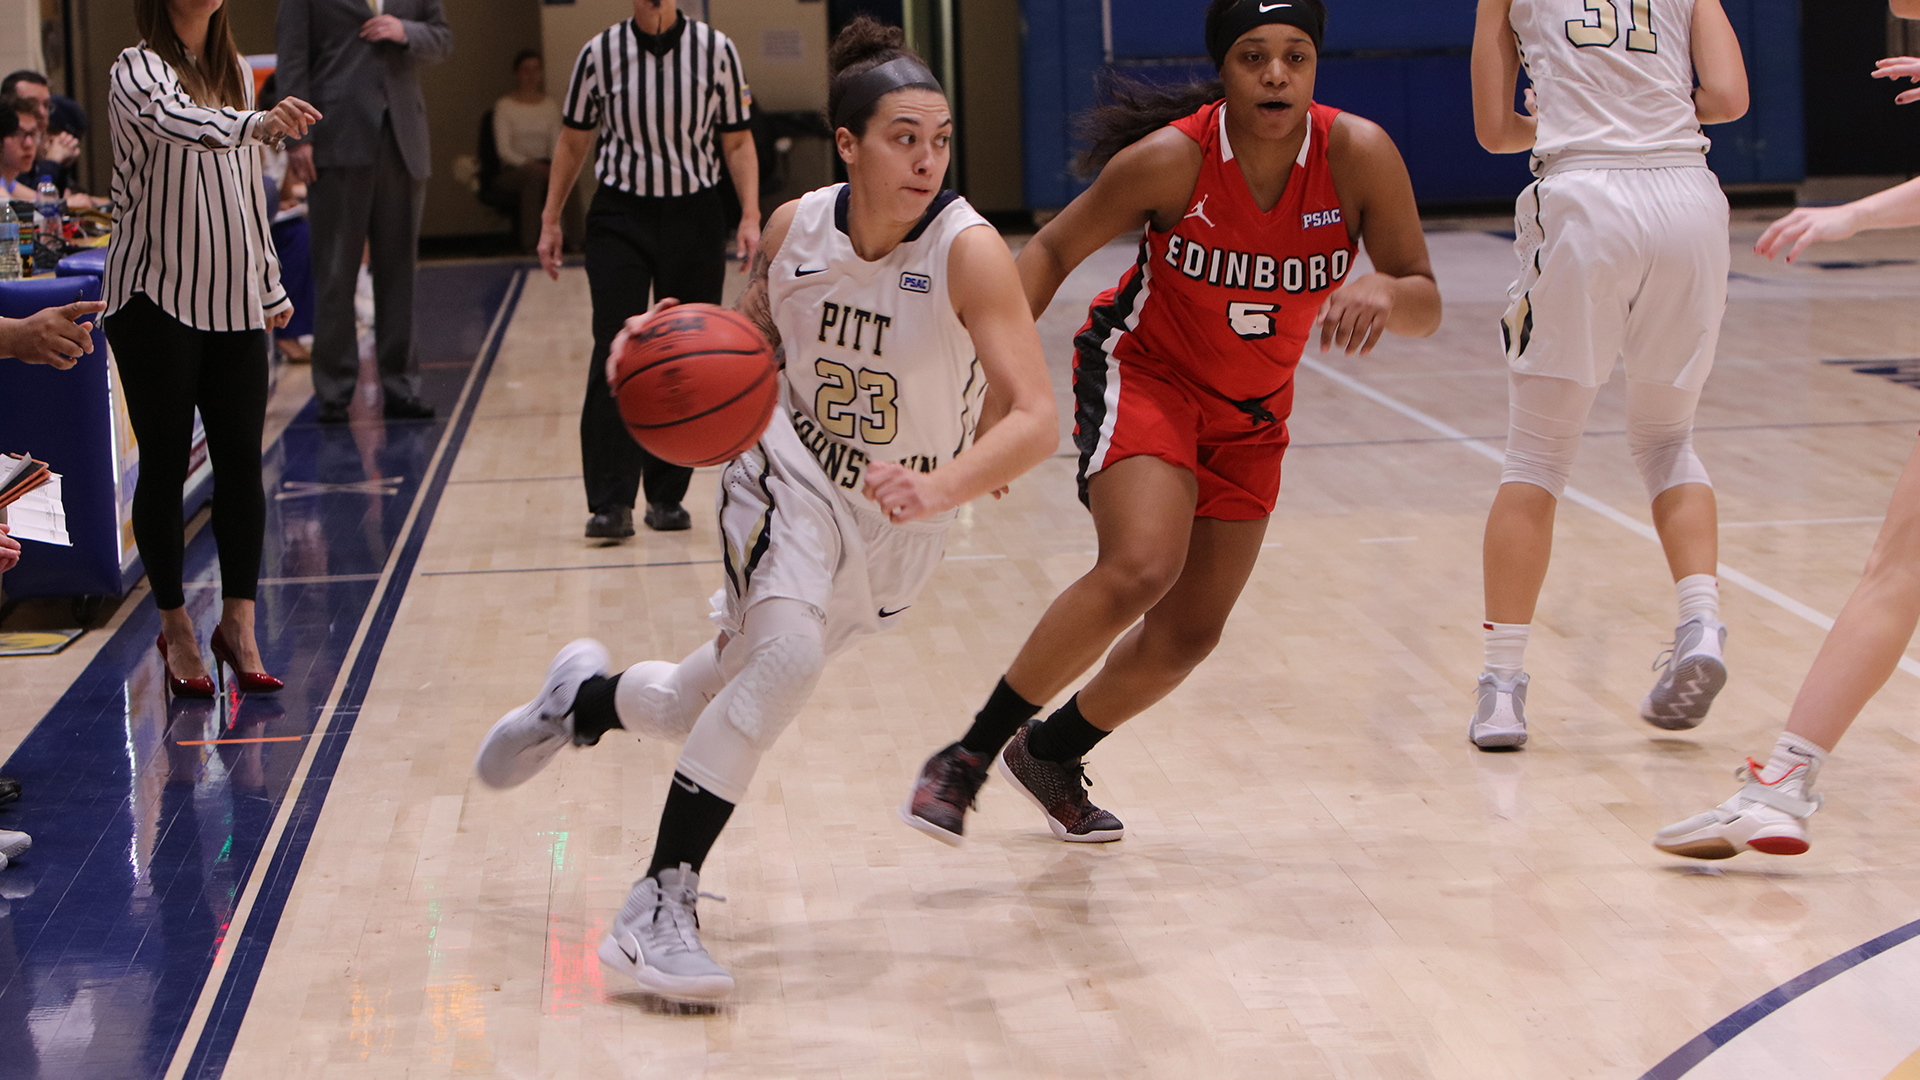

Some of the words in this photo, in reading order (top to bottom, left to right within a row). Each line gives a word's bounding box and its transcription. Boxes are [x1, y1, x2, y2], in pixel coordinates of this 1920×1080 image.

[1565, 0, 1657, 54] 31
[1302, 208, 1342, 229] PSAC
[903, 276, 928, 290] PSAC
[1164, 233, 1349, 294] EDINBORO
[818, 301, 891, 356] PITT
[1226, 300, 1281, 341] 5
[814, 357, 898, 445] 23
